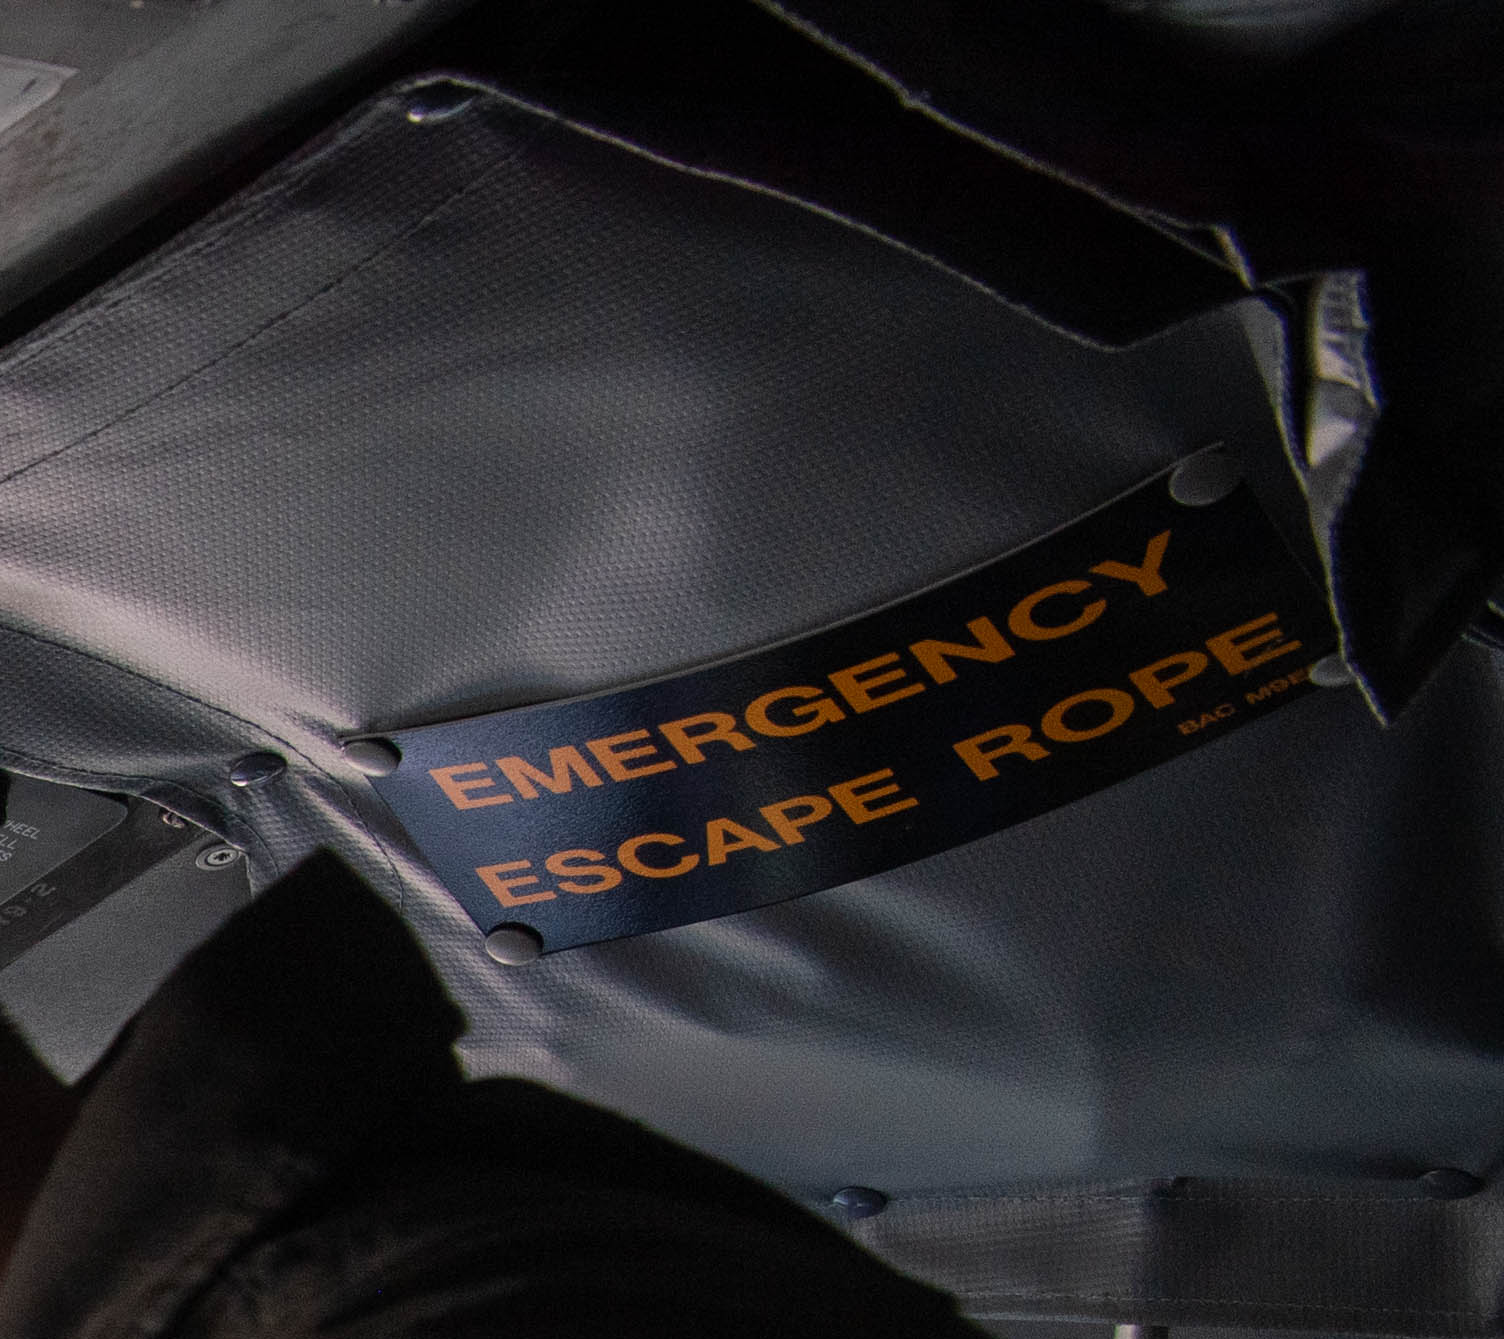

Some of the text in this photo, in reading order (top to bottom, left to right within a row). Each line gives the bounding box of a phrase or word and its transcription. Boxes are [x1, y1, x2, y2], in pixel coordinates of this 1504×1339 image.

[429, 529, 1176, 812] EMERGENCY
[474, 611, 1306, 910] ESCAPE ROPE
